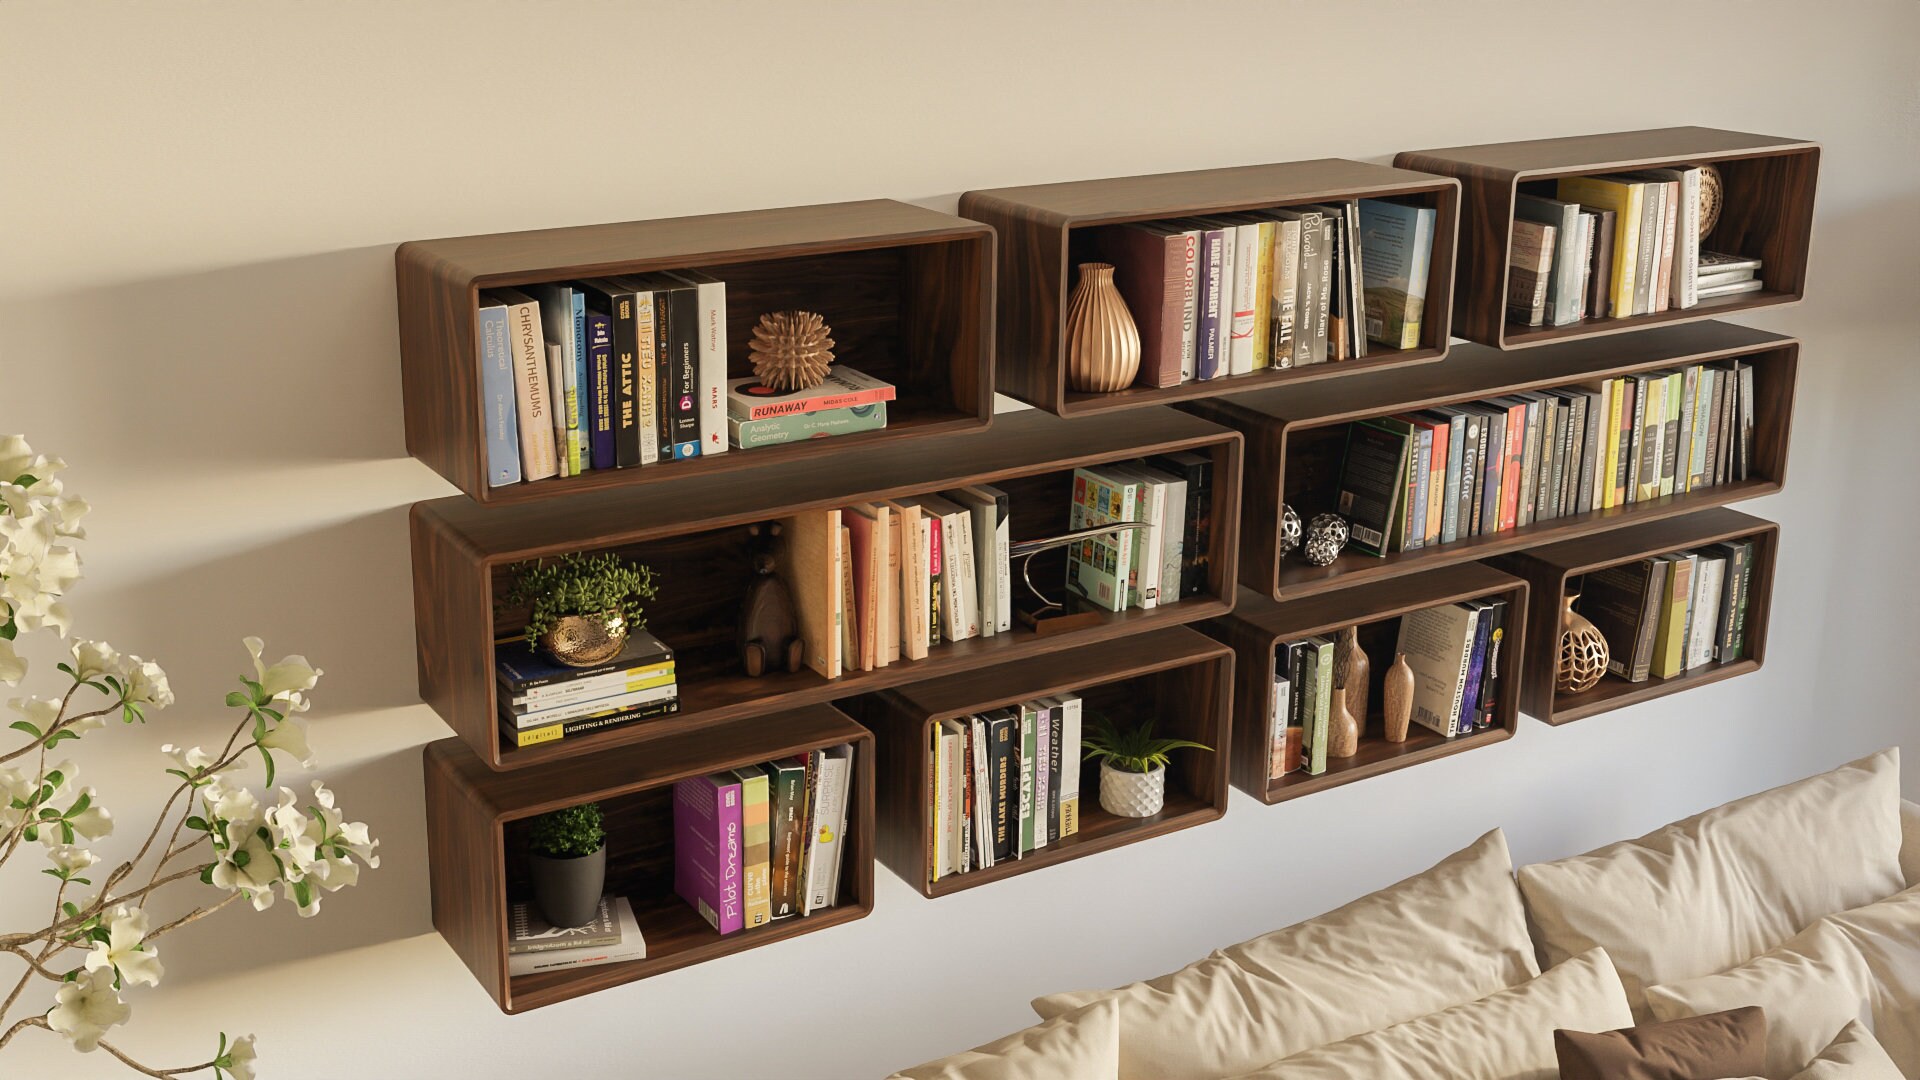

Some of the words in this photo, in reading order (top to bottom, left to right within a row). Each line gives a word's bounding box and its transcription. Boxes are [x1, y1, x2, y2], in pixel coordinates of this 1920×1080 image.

[1211, 239, 1221, 266] HARE
[1183, 236, 1196, 333] COLORBLIND
[1208, 268, 1220, 318] APPARENT
[1283, 288, 1294, 312] THE
[484, 320, 494, 358] Calculus
[495, 320, 508, 370] Theoretical
[1281, 312, 1293, 344] FALL
[520, 306, 542, 419] CHRYSANTHEMUMS
[622, 353, 632, 396] ATTIC
[683, 342, 691, 380] Beginners
[622, 401, 632, 429] THE
[751, 423, 780, 434] Analytic
[754, 402, 807, 417] RUNAWAY
[751, 431, 790, 443] Geometry
[1479, 428, 1488, 461] EXODUS
[1411, 436, 1420, 482] RESTLESS
[1462, 449, 1476, 500] Coraline
[1453, 679, 1464, 717] HOUSTON
[1461, 639, 1471, 676] MURDERS
[566, 720, 598, 734] LIGHTING
[605, 712, 642, 726] RENDERING
[1051, 719, 1060, 774] Weather
[821, 765, 835, 816] SURPRISE
[999, 756, 1007, 800] MURDERS
[1022, 756, 1032, 819] ESCAPEE
[998, 802, 1006, 825] LAKE
[725, 822, 737, 879] Dreams
[998, 827, 1006, 844] THE
[725, 883, 738, 919] Pilot
